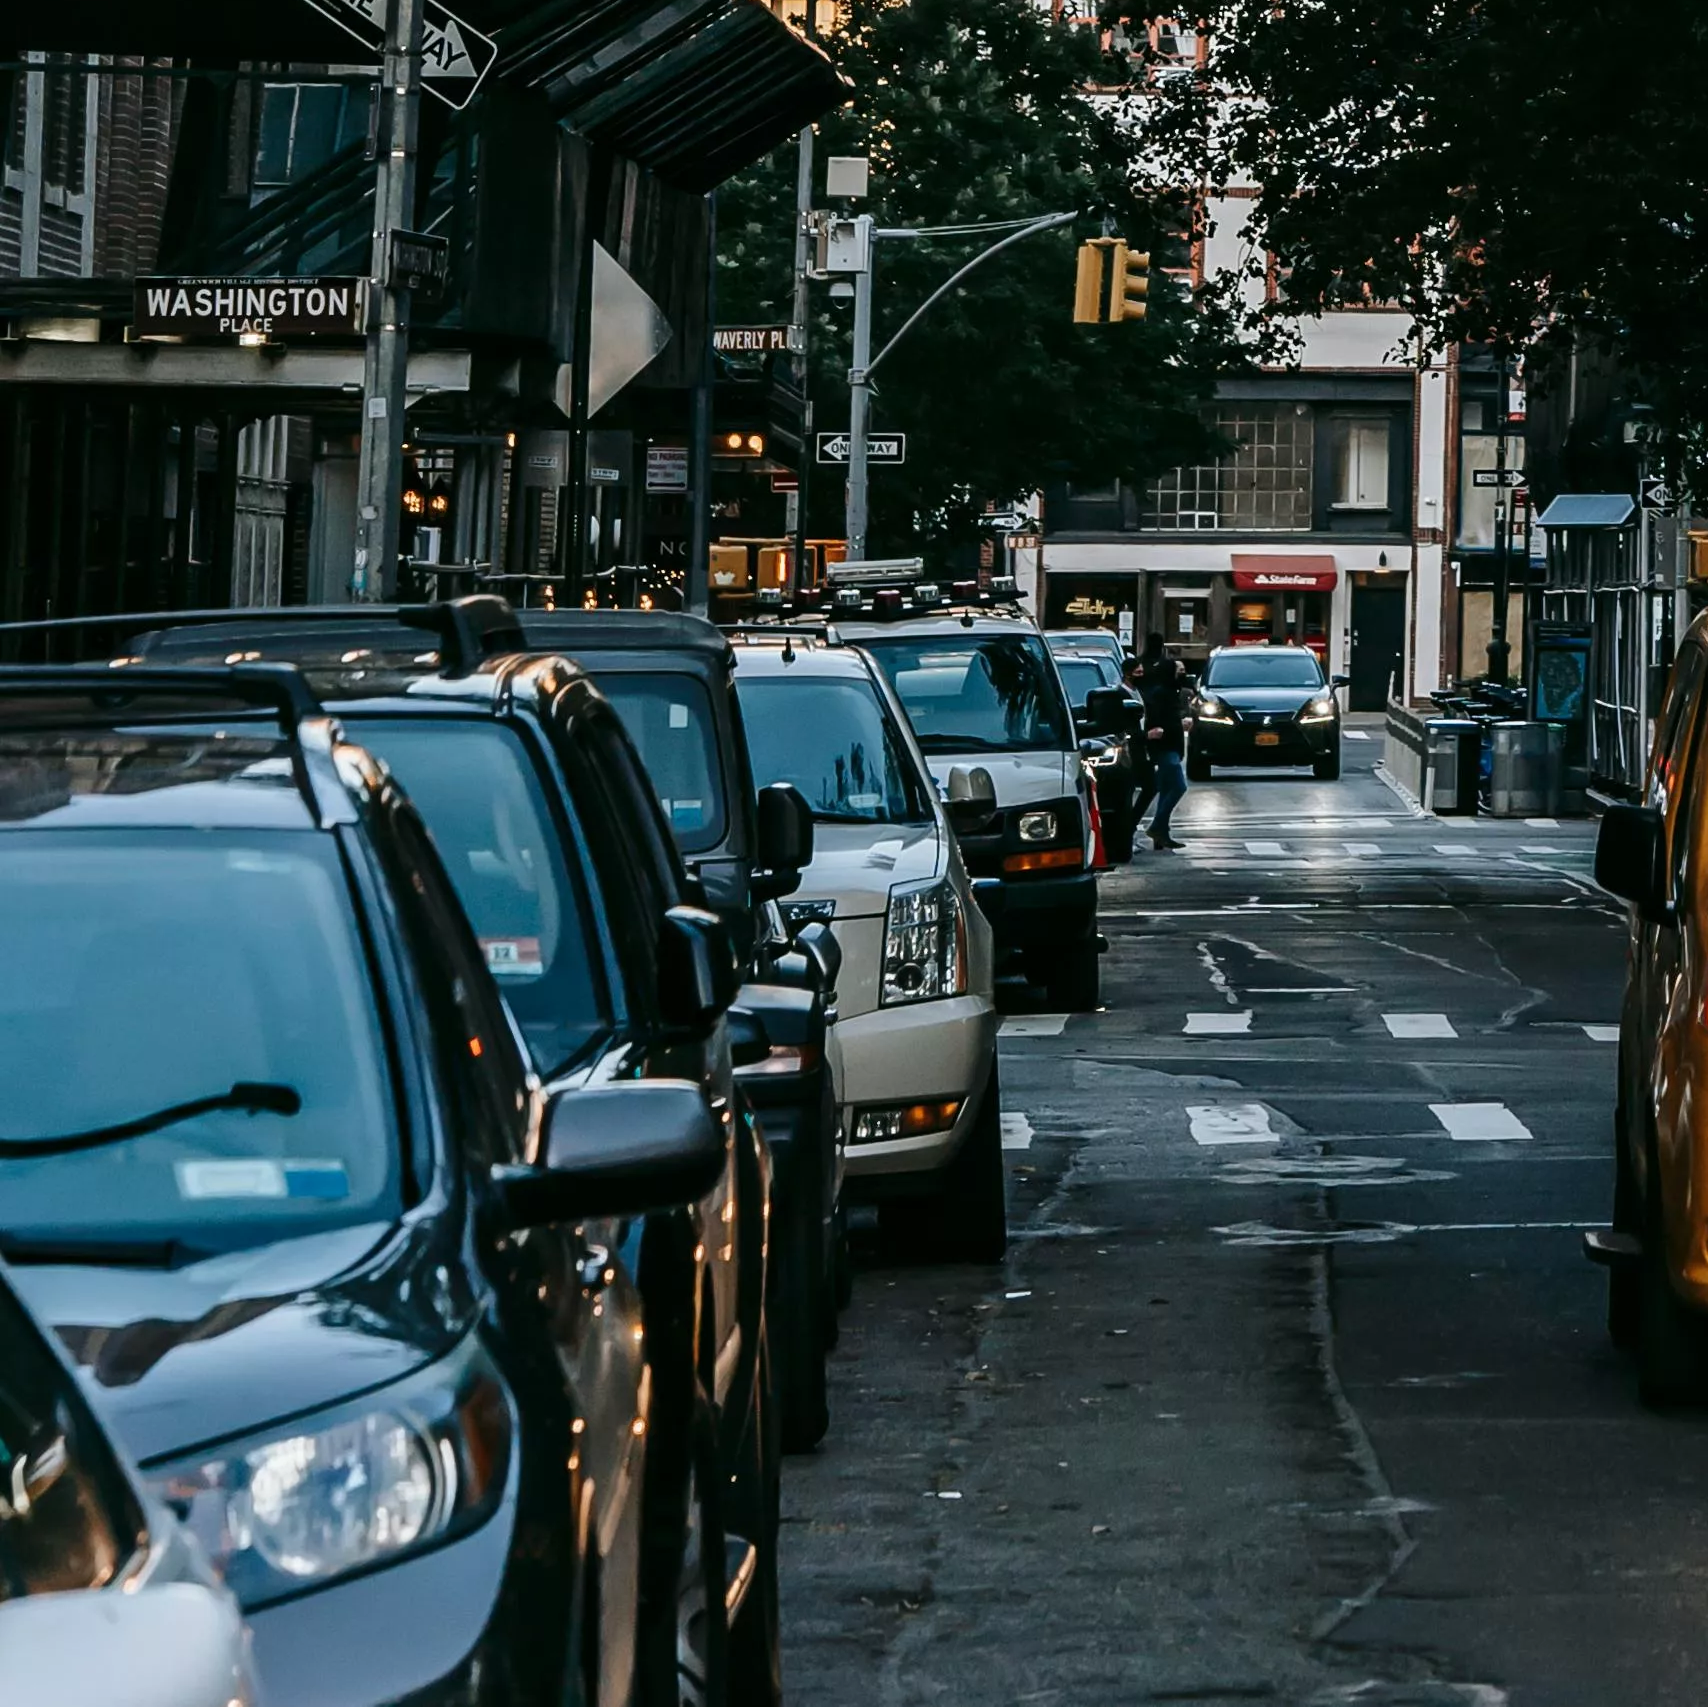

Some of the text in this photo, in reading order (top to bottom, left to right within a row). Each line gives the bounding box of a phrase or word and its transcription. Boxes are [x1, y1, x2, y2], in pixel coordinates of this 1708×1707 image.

[146, 287, 348, 317] WASHINGTON
[219, 317, 273, 333] PLACE
[713, 330, 766, 350] WAVERLY
[867, 443, 893, 454] WAY
[1655, 489, 1672, 500] ON
